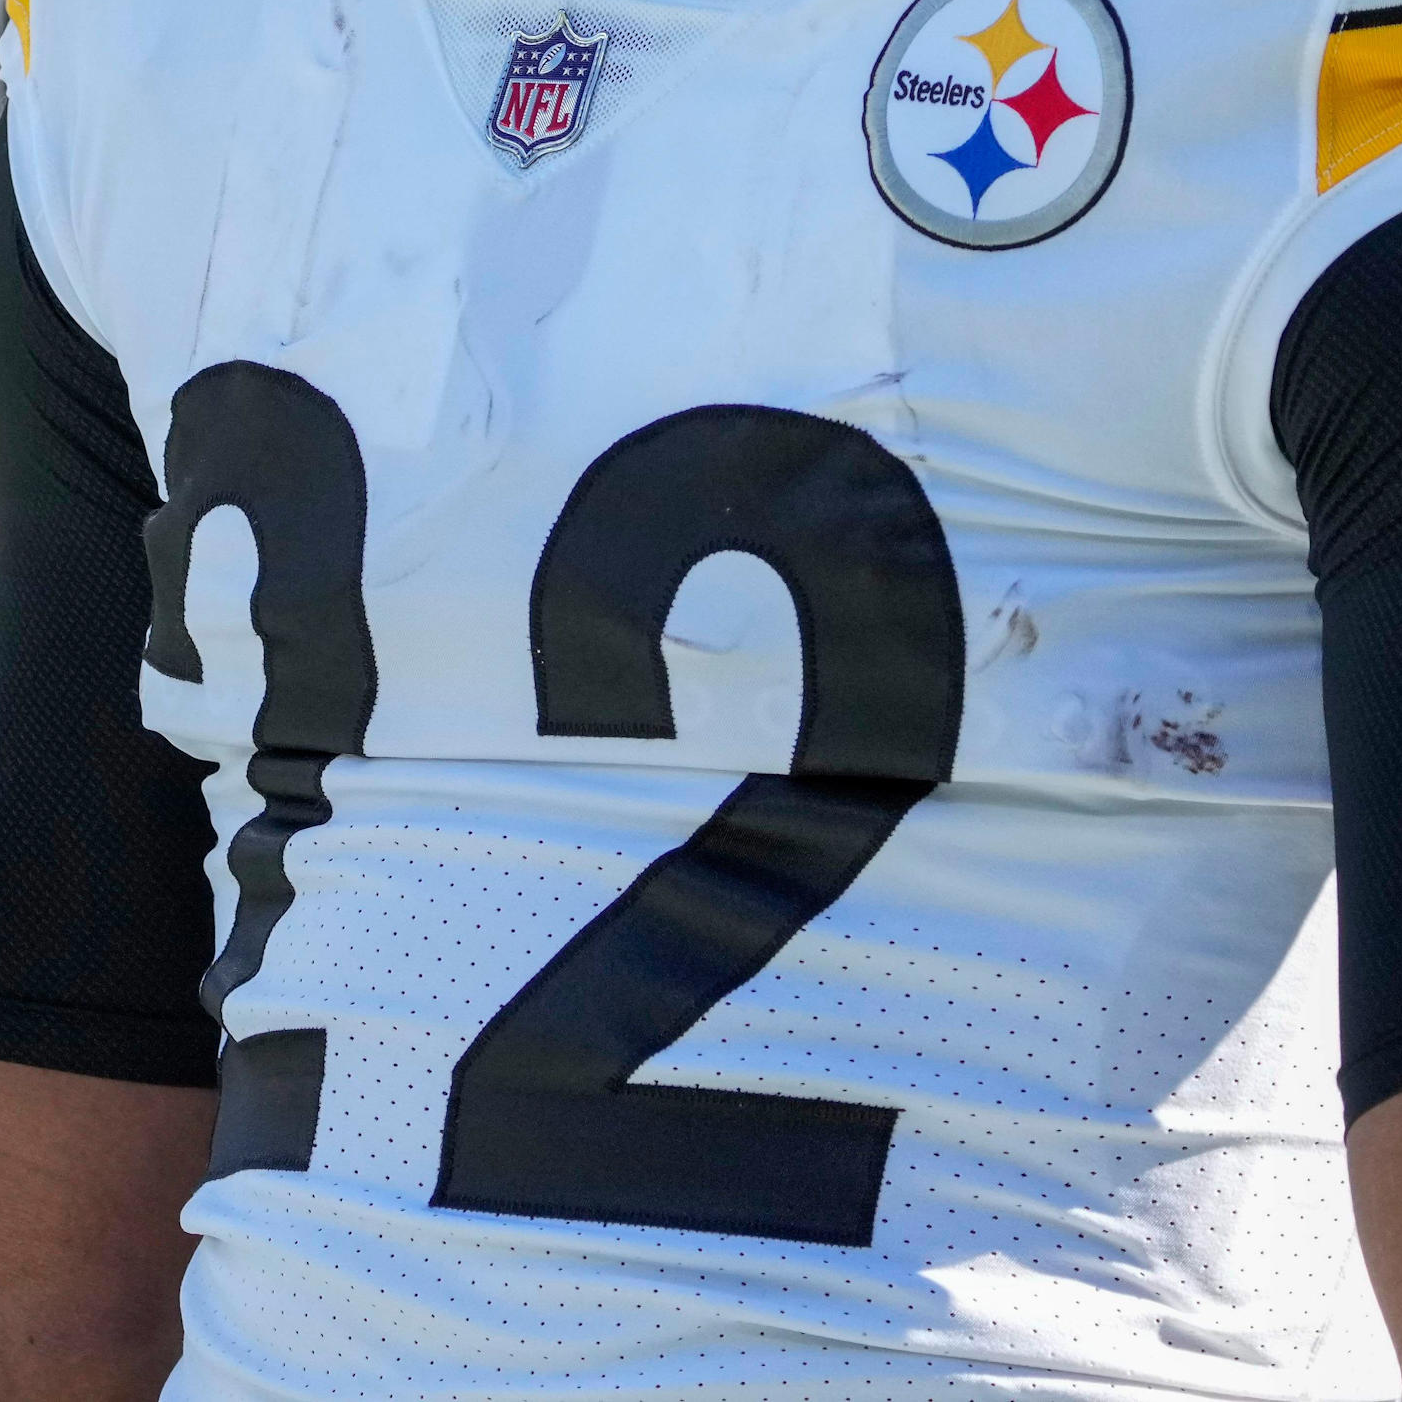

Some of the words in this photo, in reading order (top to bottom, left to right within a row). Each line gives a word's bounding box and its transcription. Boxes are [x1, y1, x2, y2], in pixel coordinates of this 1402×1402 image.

[500, 82, 571, 139] NFL
[894, 70, 985, 109] Steelers
[143, 358, 965, 1248] 22
